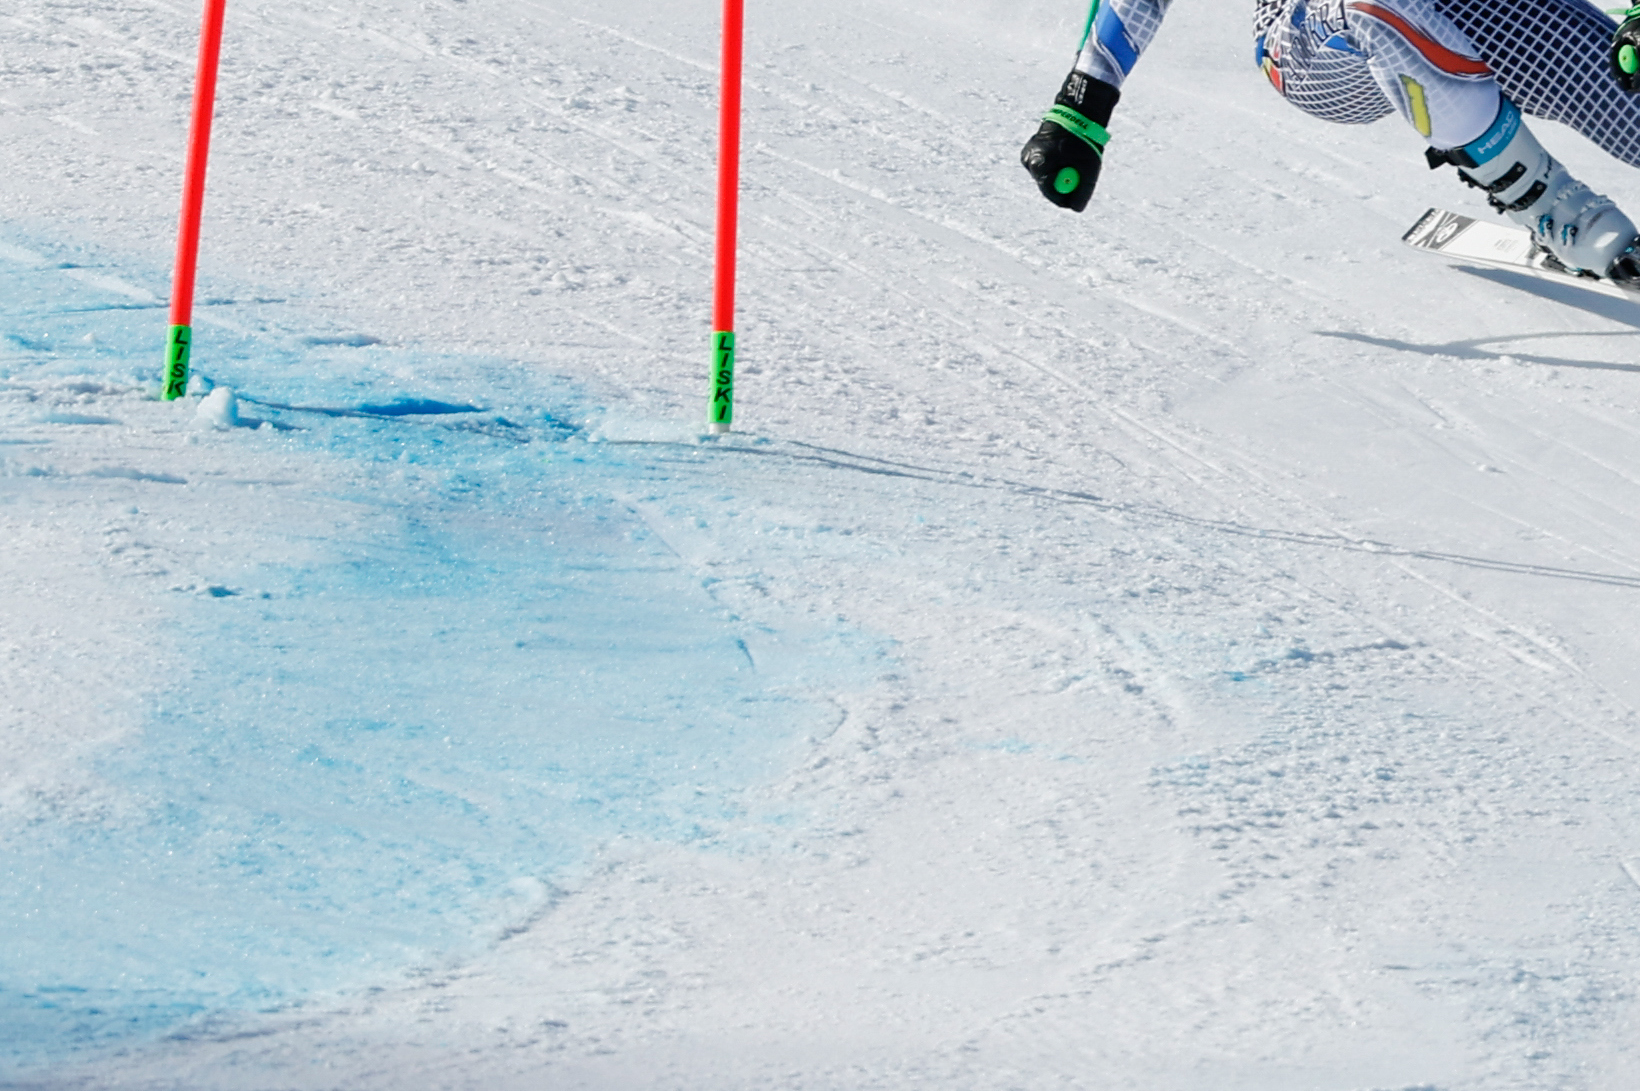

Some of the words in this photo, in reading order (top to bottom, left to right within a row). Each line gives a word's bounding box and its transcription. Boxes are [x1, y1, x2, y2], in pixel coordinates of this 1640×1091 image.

[1477, 110, 1514, 154] HEAD
[167, 329, 188, 396] LISK
[713, 335, 732, 421] LISKI
